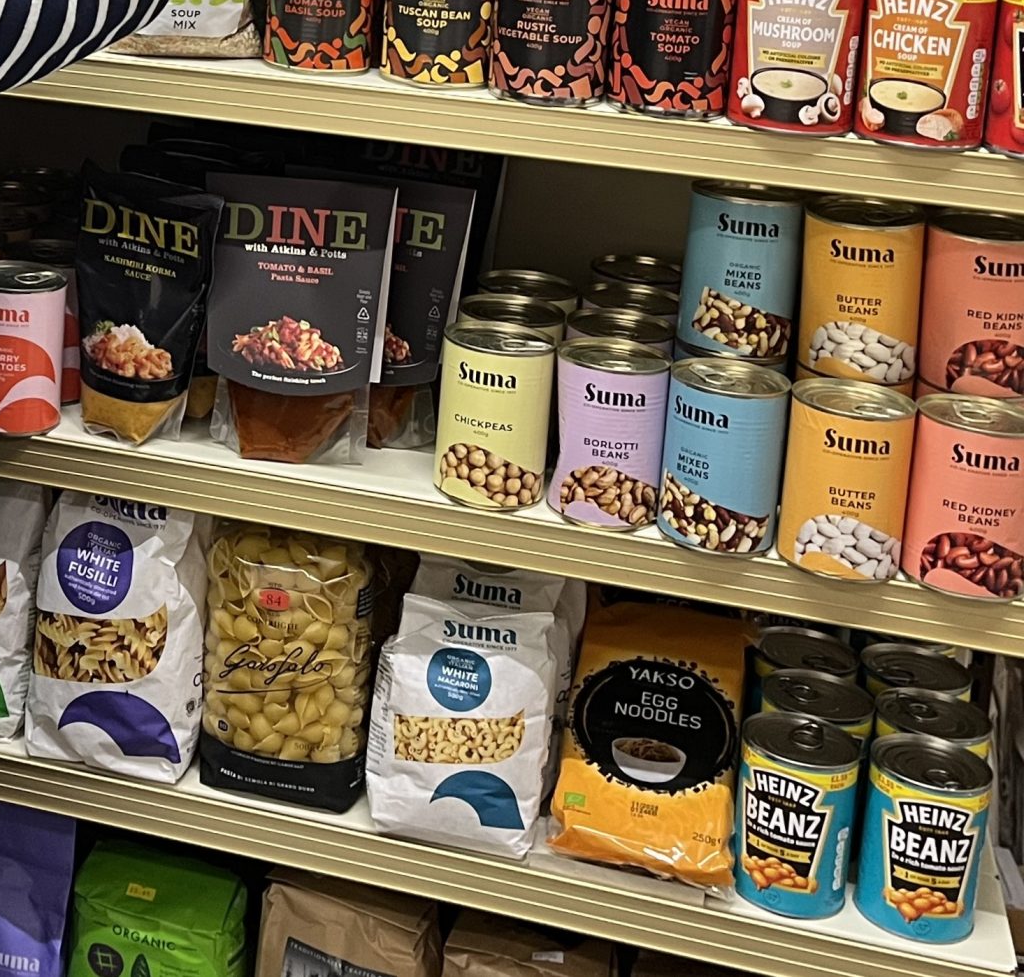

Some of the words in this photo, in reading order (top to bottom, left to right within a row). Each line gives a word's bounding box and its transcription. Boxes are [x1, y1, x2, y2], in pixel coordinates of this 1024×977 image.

[284, 5, 313, 17] BASIL
[316, 8, 346, 18] SOUP
[335, 0, 343, 8] &
[171, 9, 201, 19] SOUP
[397, 5, 438, 19] TUSCAN
[440, 10, 471, 21] BEAN
[777, 14, 801, 24] CREAM
[173, 20, 197, 30] MIX
[416, 17, 448, 29] SOUP
[516, 20, 557, 33] RUSTIC
[498, 27, 550, 43] VEGETABLE
[553, 34, 583, 45] SOUP
[650, 31, 700, 45] TOMATO
[753, 20, 836, 43] MUSHROOM
[657, 43, 691, 55] SOUP
[874, 29, 952, 56] CHICKEN
[81, 197, 199, 259] DINE
[224, 201, 368, 251] DINE
[718, 212, 780, 238] Suma
[244, 242, 268, 253] with
[271, 243, 306, 257] Atkins
[309, 247, 318, 257] &
[321, 248, 347, 260] Potts
[104, 254, 143, 271] KASHMIRI
[145, 264, 177, 278] KORMA
[125, 270, 152, 281] SAUCE
[726, 269, 762, 281] MIXED
[724, 278, 762, 290] BEANS
[836, 294, 882, 307] BUTTER
[838, 304, 879, 316] BEANS
[983, 320, 1023, 332] BEANS
[675, 395, 729, 429] Suma
[454, 413, 513, 432] CHICKPEAS
[583, 437, 639, 451] BORLOTTI
[942, 499, 968, 513] RED
[972, 505, 1016, 518] KIDNEY
[958, 513, 1000, 528] BEANS
[87, 531, 122, 550] ORGANIC
[76, 547, 121, 572] WHITE
[68, 561, 118, 587] FUSILLI
[453, 574, 522, 602] Suma
[77, 591, 96, 606] 500g
[265, 593, 282, 607] 84
[219, 643, 330, 686] Garofalo
[437, 675, 479, 691] MACARONI
[628, 666, 695, 691] YAKSO
[641, 691, 678, 711] EGG
[614, 701, 702, 730] NOODLES
[755, 772, 816, 807] HEINZ
[746, 792, 821, 840] BEANZ
[692, 831, 716, 847] 250g
